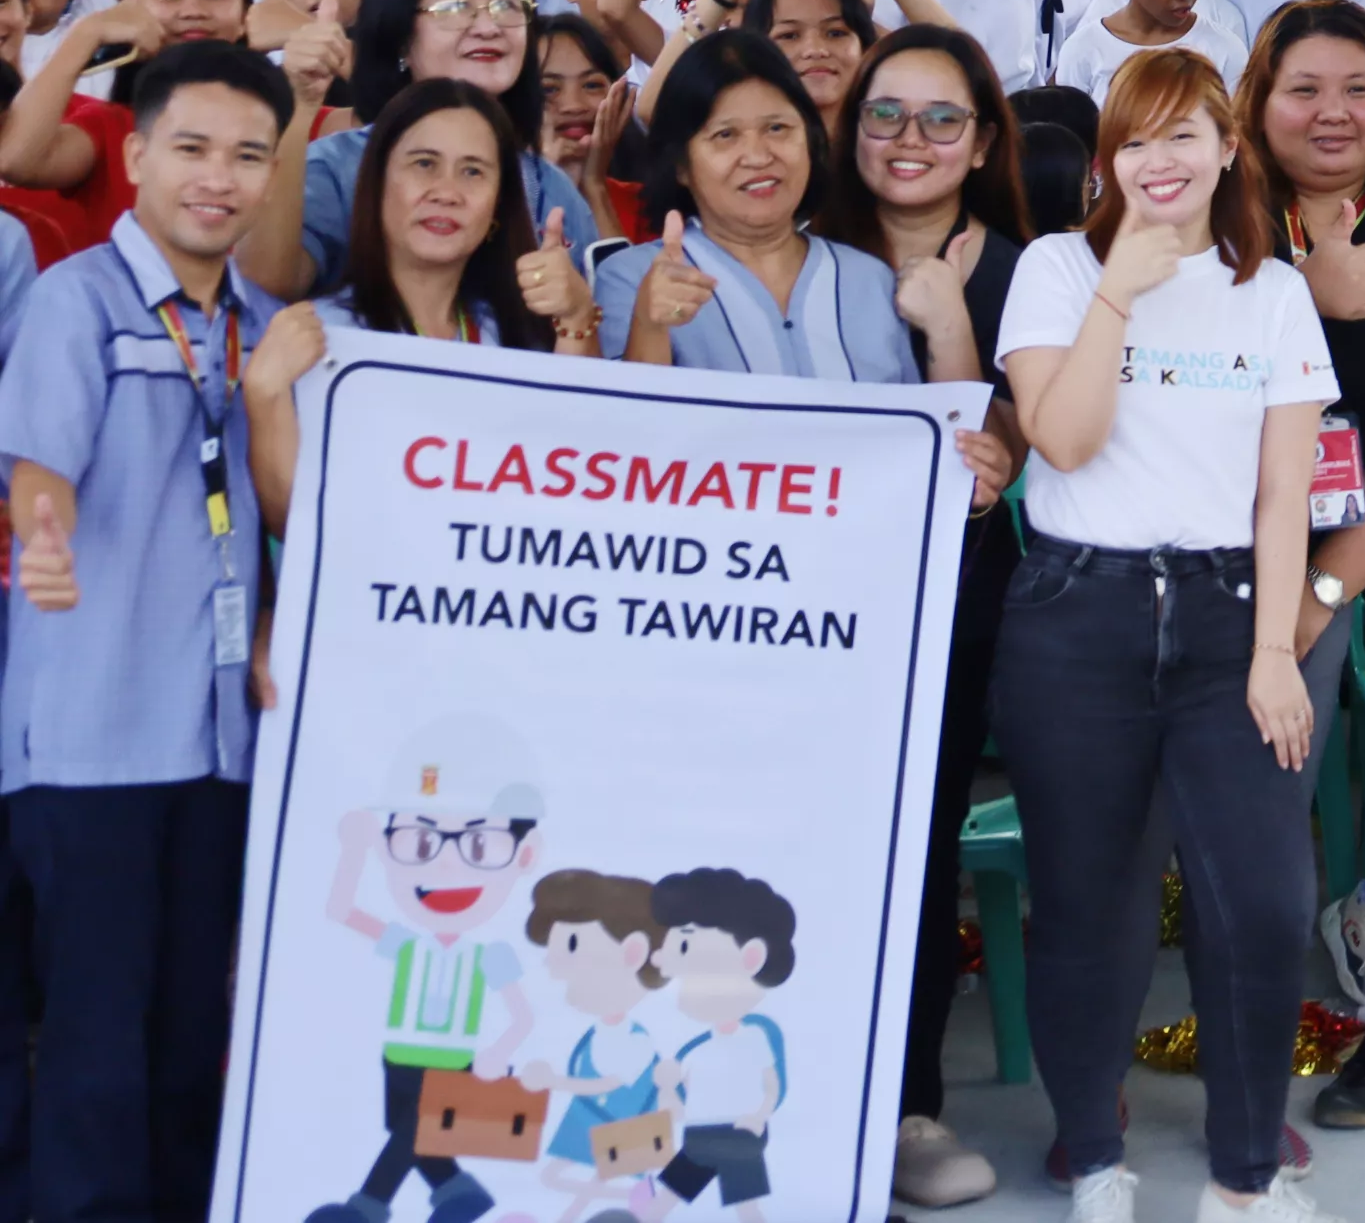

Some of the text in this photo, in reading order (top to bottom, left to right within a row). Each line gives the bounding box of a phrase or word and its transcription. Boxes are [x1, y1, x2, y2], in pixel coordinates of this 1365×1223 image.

[402, 435, 842, 518] CLASSMATE!
[449, 522, 791, 583] TUMAWID SA
[370, 582, 859, 650] TAMANG TAWIRAN
